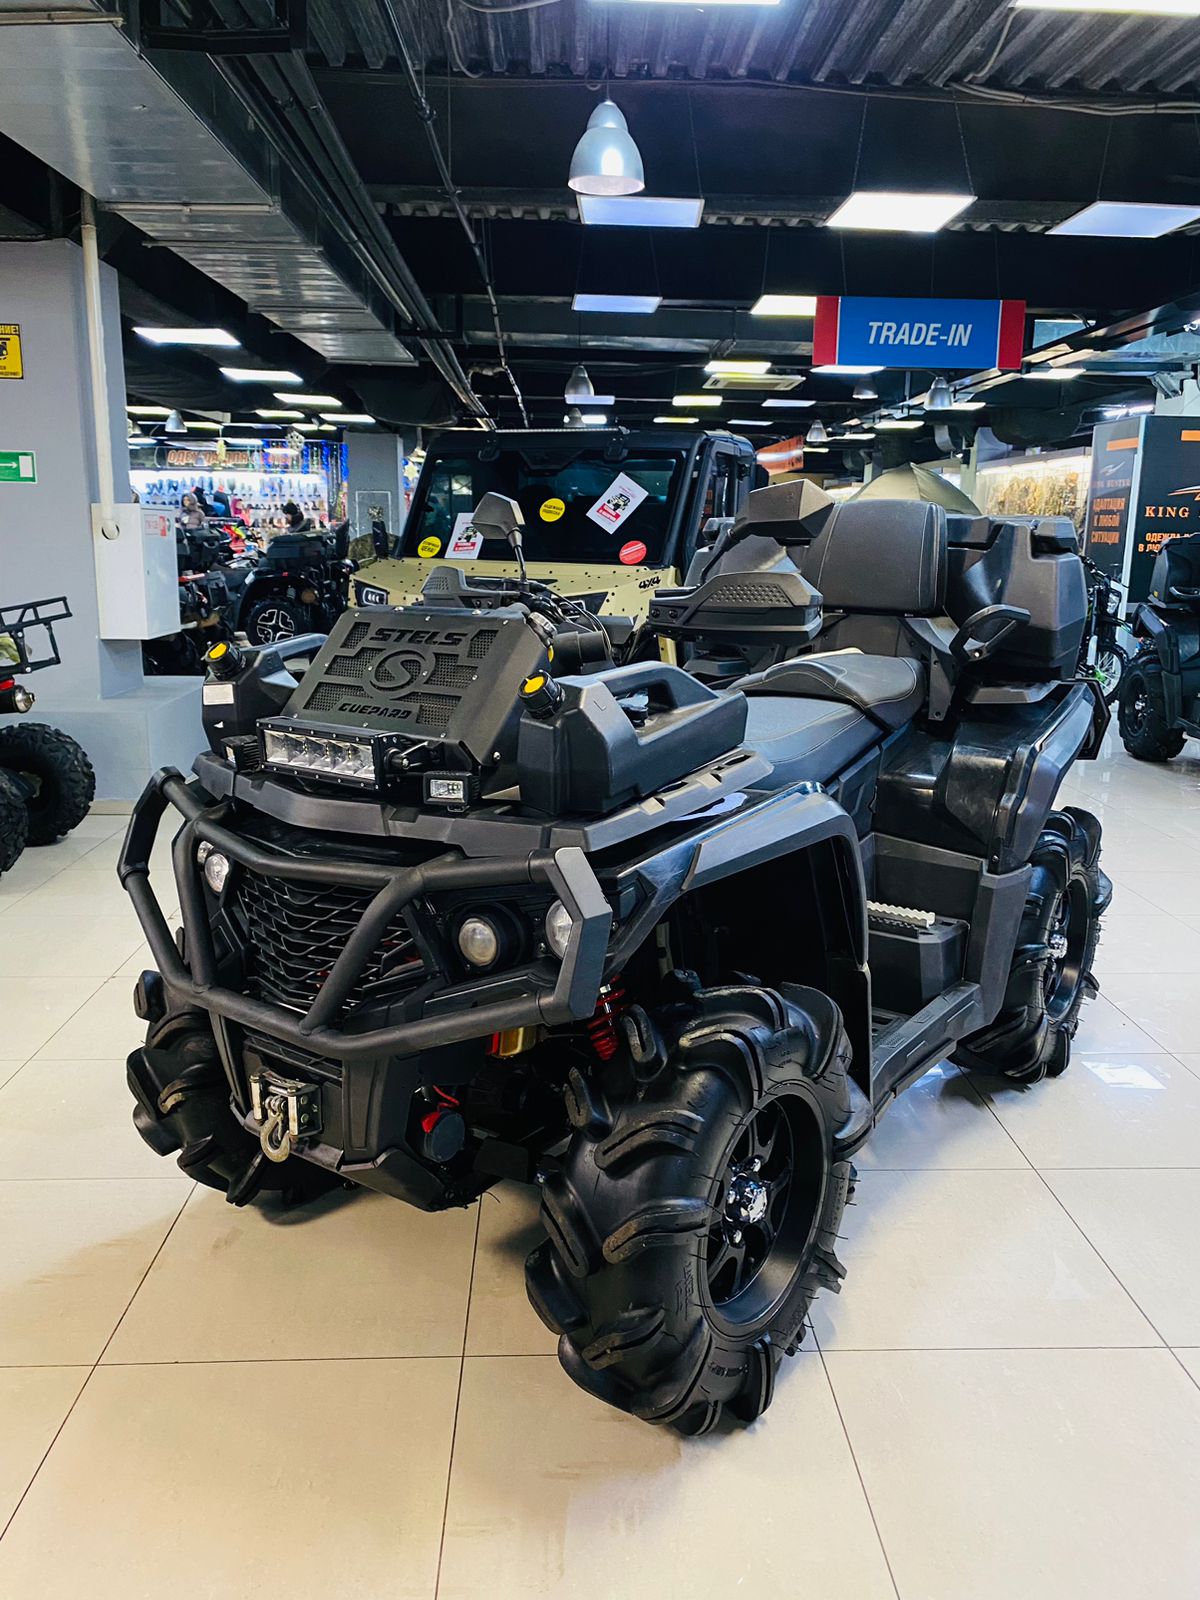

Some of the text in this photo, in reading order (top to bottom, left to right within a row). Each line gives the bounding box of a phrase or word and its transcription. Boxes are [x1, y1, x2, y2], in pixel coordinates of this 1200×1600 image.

[868, 321, 973, 347] TRADE-IN
[1144, 505, 1190, 518] KING
[369, 627, 468, 647] STELS
[338, 702, 412, 720] GUEPARD
